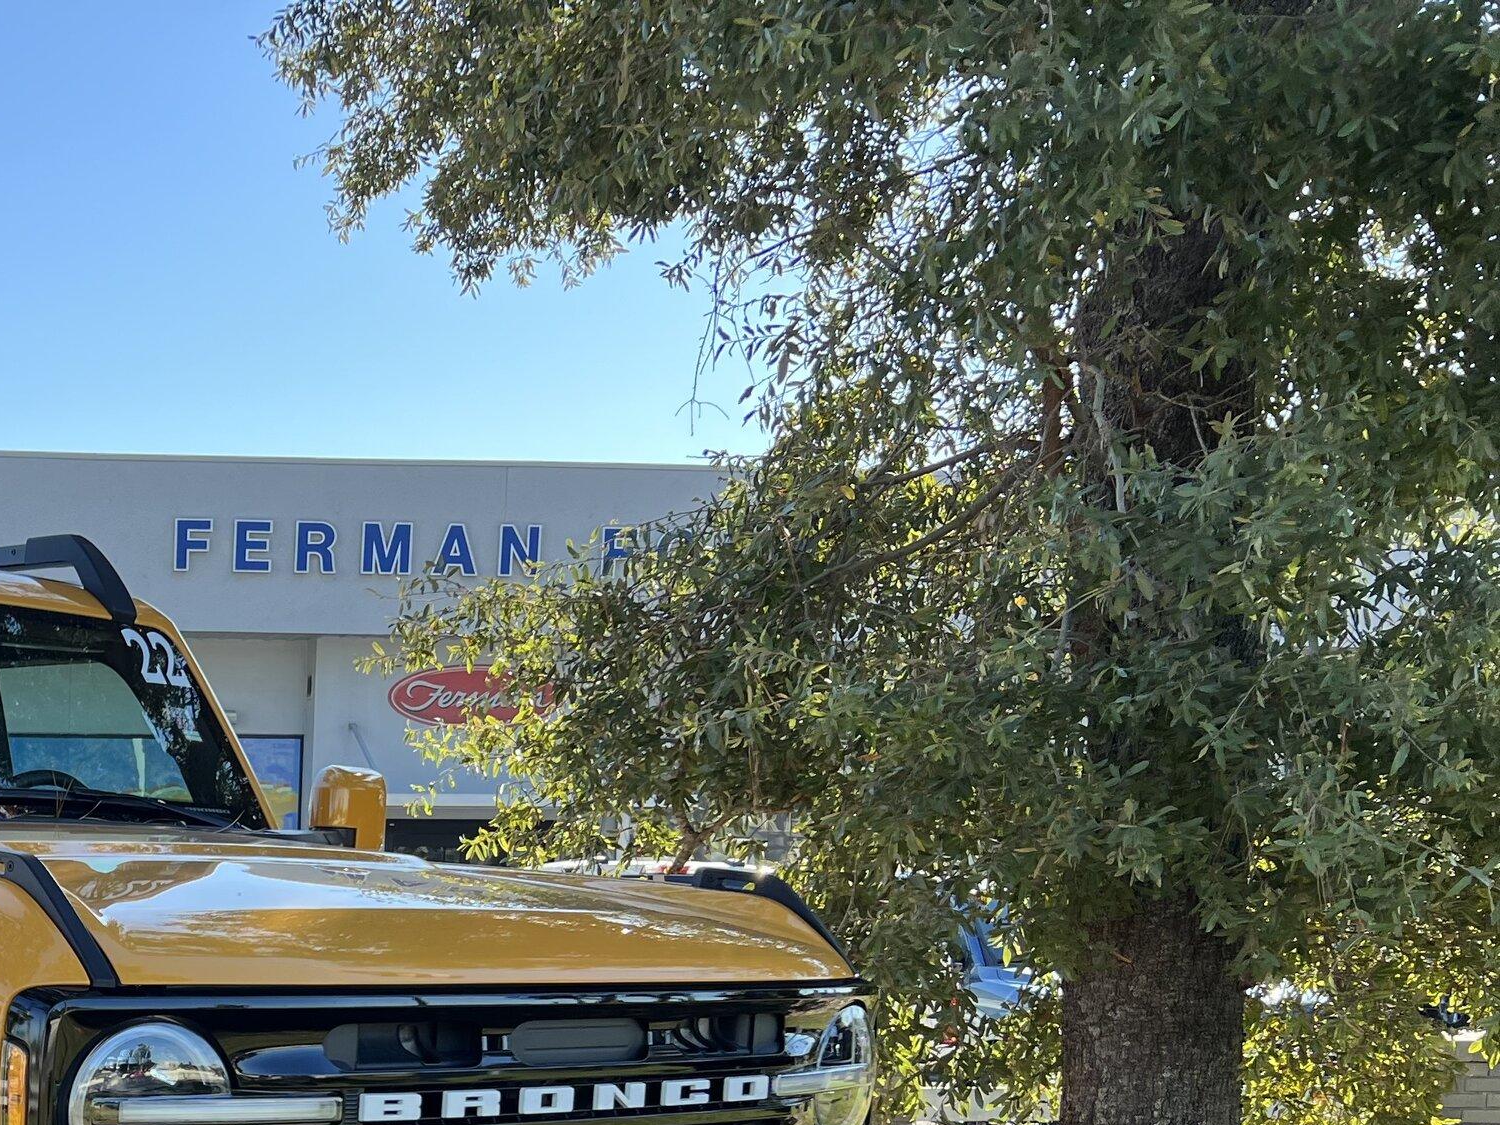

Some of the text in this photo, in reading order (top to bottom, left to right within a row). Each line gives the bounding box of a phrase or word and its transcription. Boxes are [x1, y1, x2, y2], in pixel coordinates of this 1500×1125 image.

[173, 518, 543, 577] FERMAN
[120, 627, 192, 688] 22
[357, 1074, 770, 1123] BRONCO
